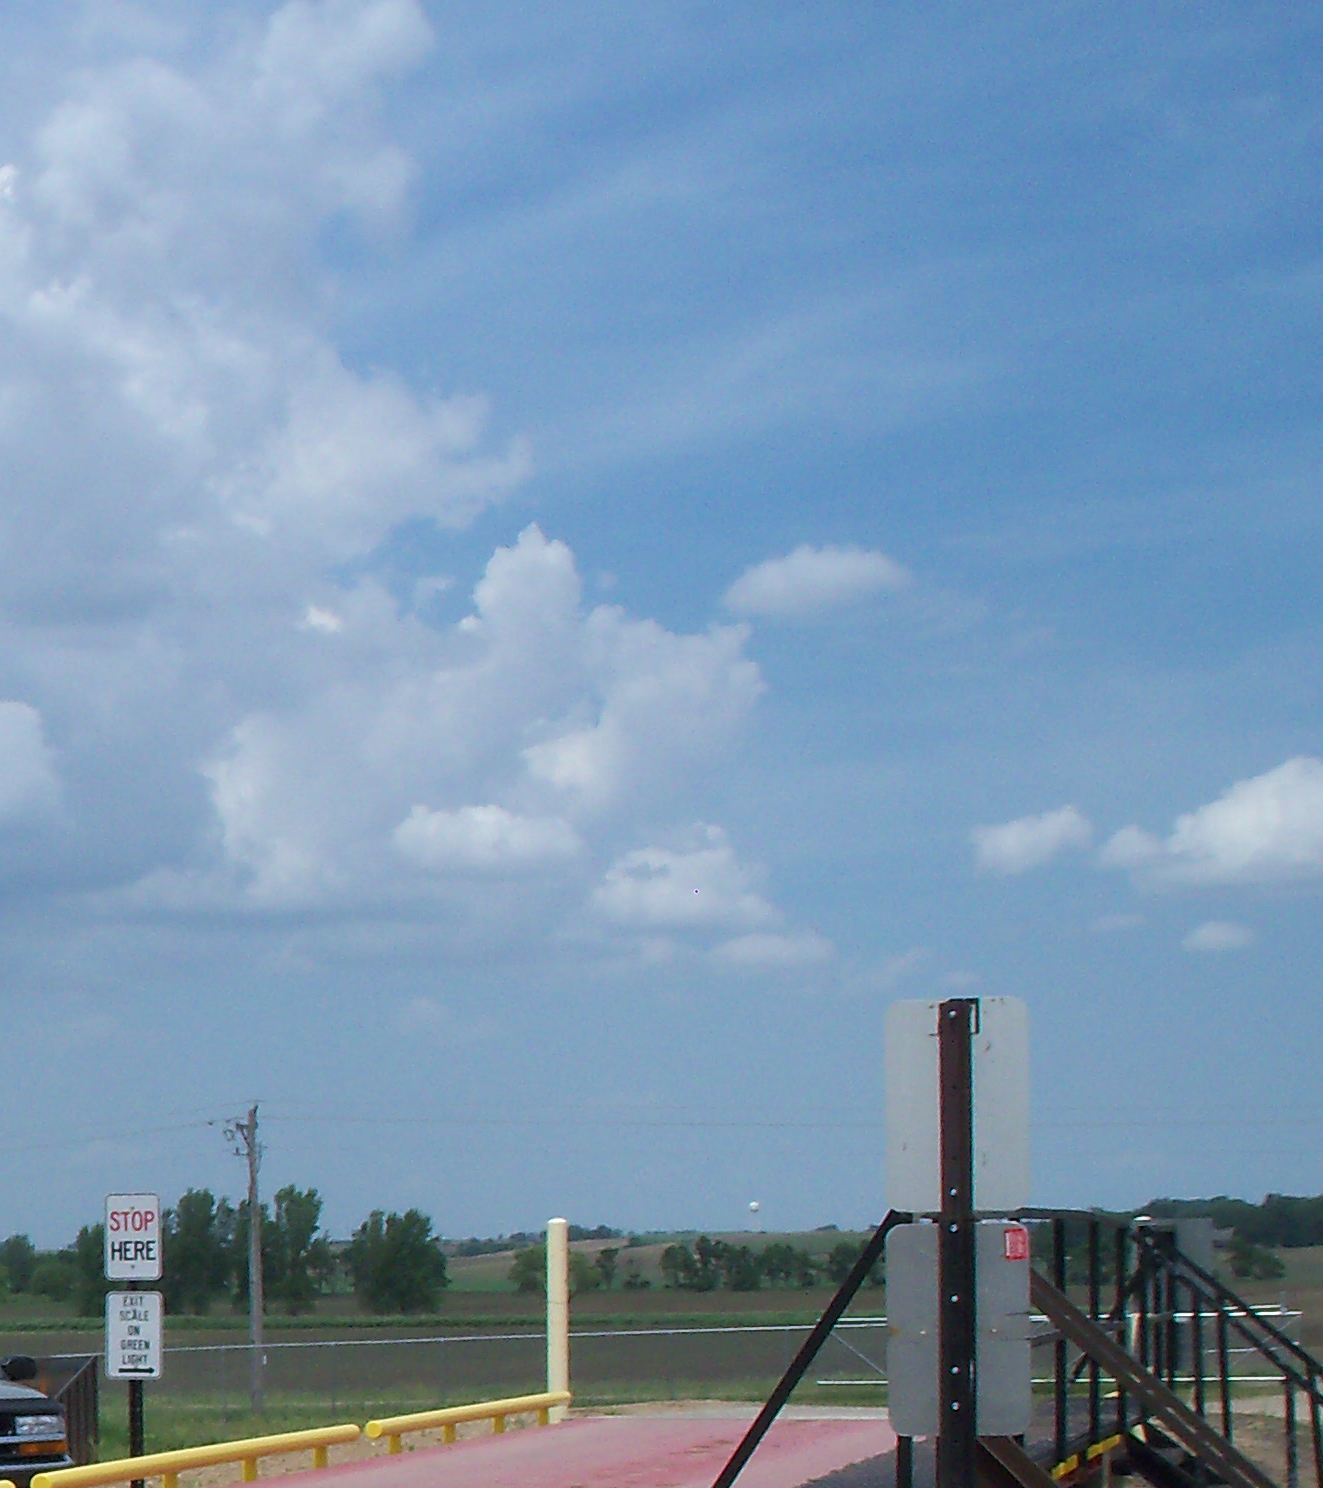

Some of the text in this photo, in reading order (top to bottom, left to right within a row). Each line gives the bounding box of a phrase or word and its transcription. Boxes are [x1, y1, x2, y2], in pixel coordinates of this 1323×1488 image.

[110, 1211, 155, 1232] STOP
[111, 1241, 157, 1261] HERE
[123, 1296, 144, 1307] EXIT
[119, 1310, 149, 1321] SCALE
[127, 1325, 140, 1336] ON
[120, 1339, 150, 1351] GREEN
[122, 1354, 148, 1365] LIGHT
